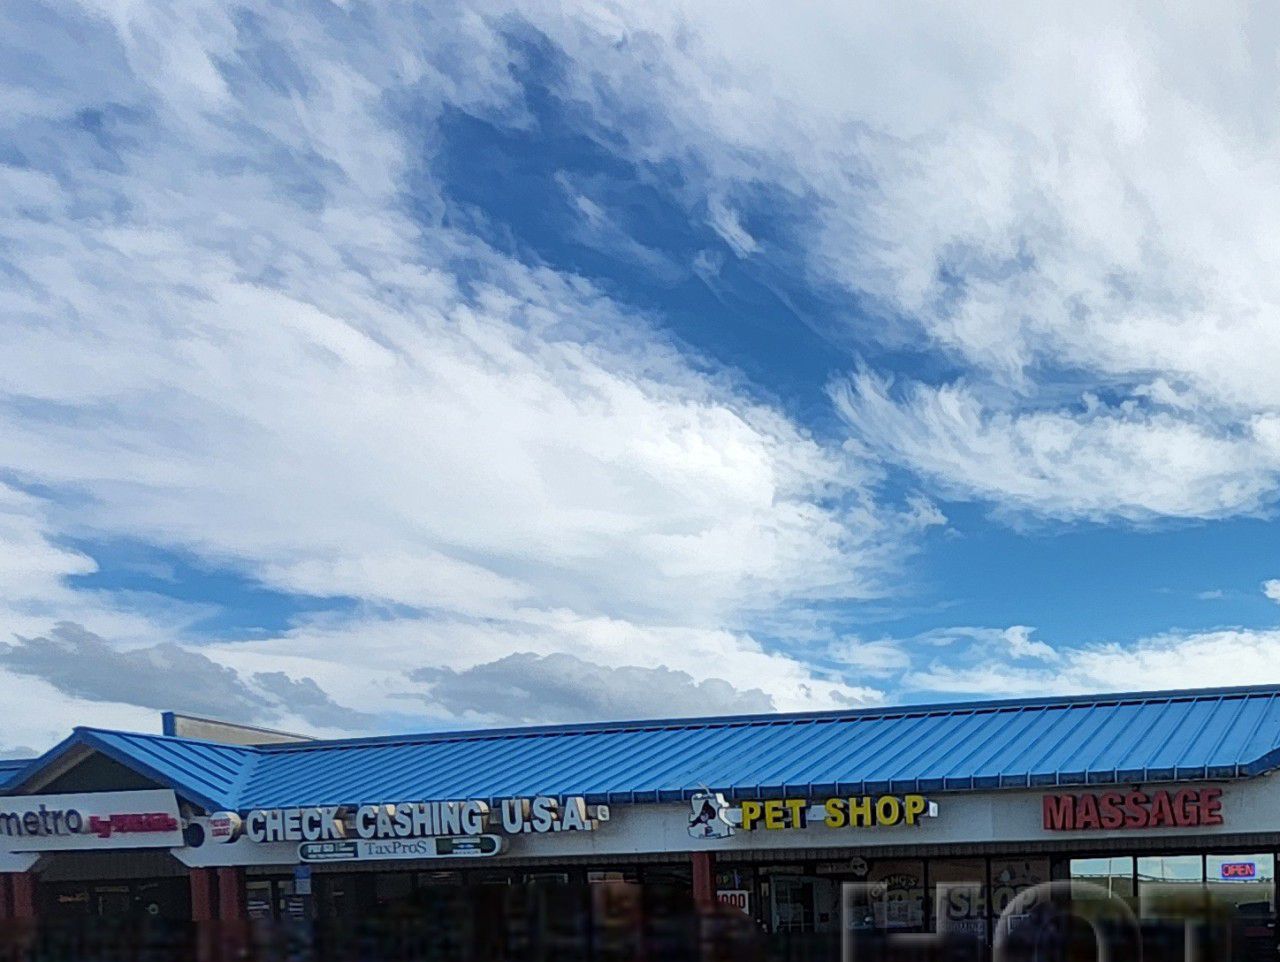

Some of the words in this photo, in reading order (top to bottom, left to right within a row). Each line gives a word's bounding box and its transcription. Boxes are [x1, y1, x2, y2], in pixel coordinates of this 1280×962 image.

[0, 803, 83, 837] metro
[246, 810, 340, 843] CHECK
[356, 799, 484, 838] CASHING
[741, 799, 807, 831] PET
[824, 794, 926, 828] SHOP
[1042, 787, 1224, 831] MASSAGE
[1222, 864, 1254, 877] OPEN
